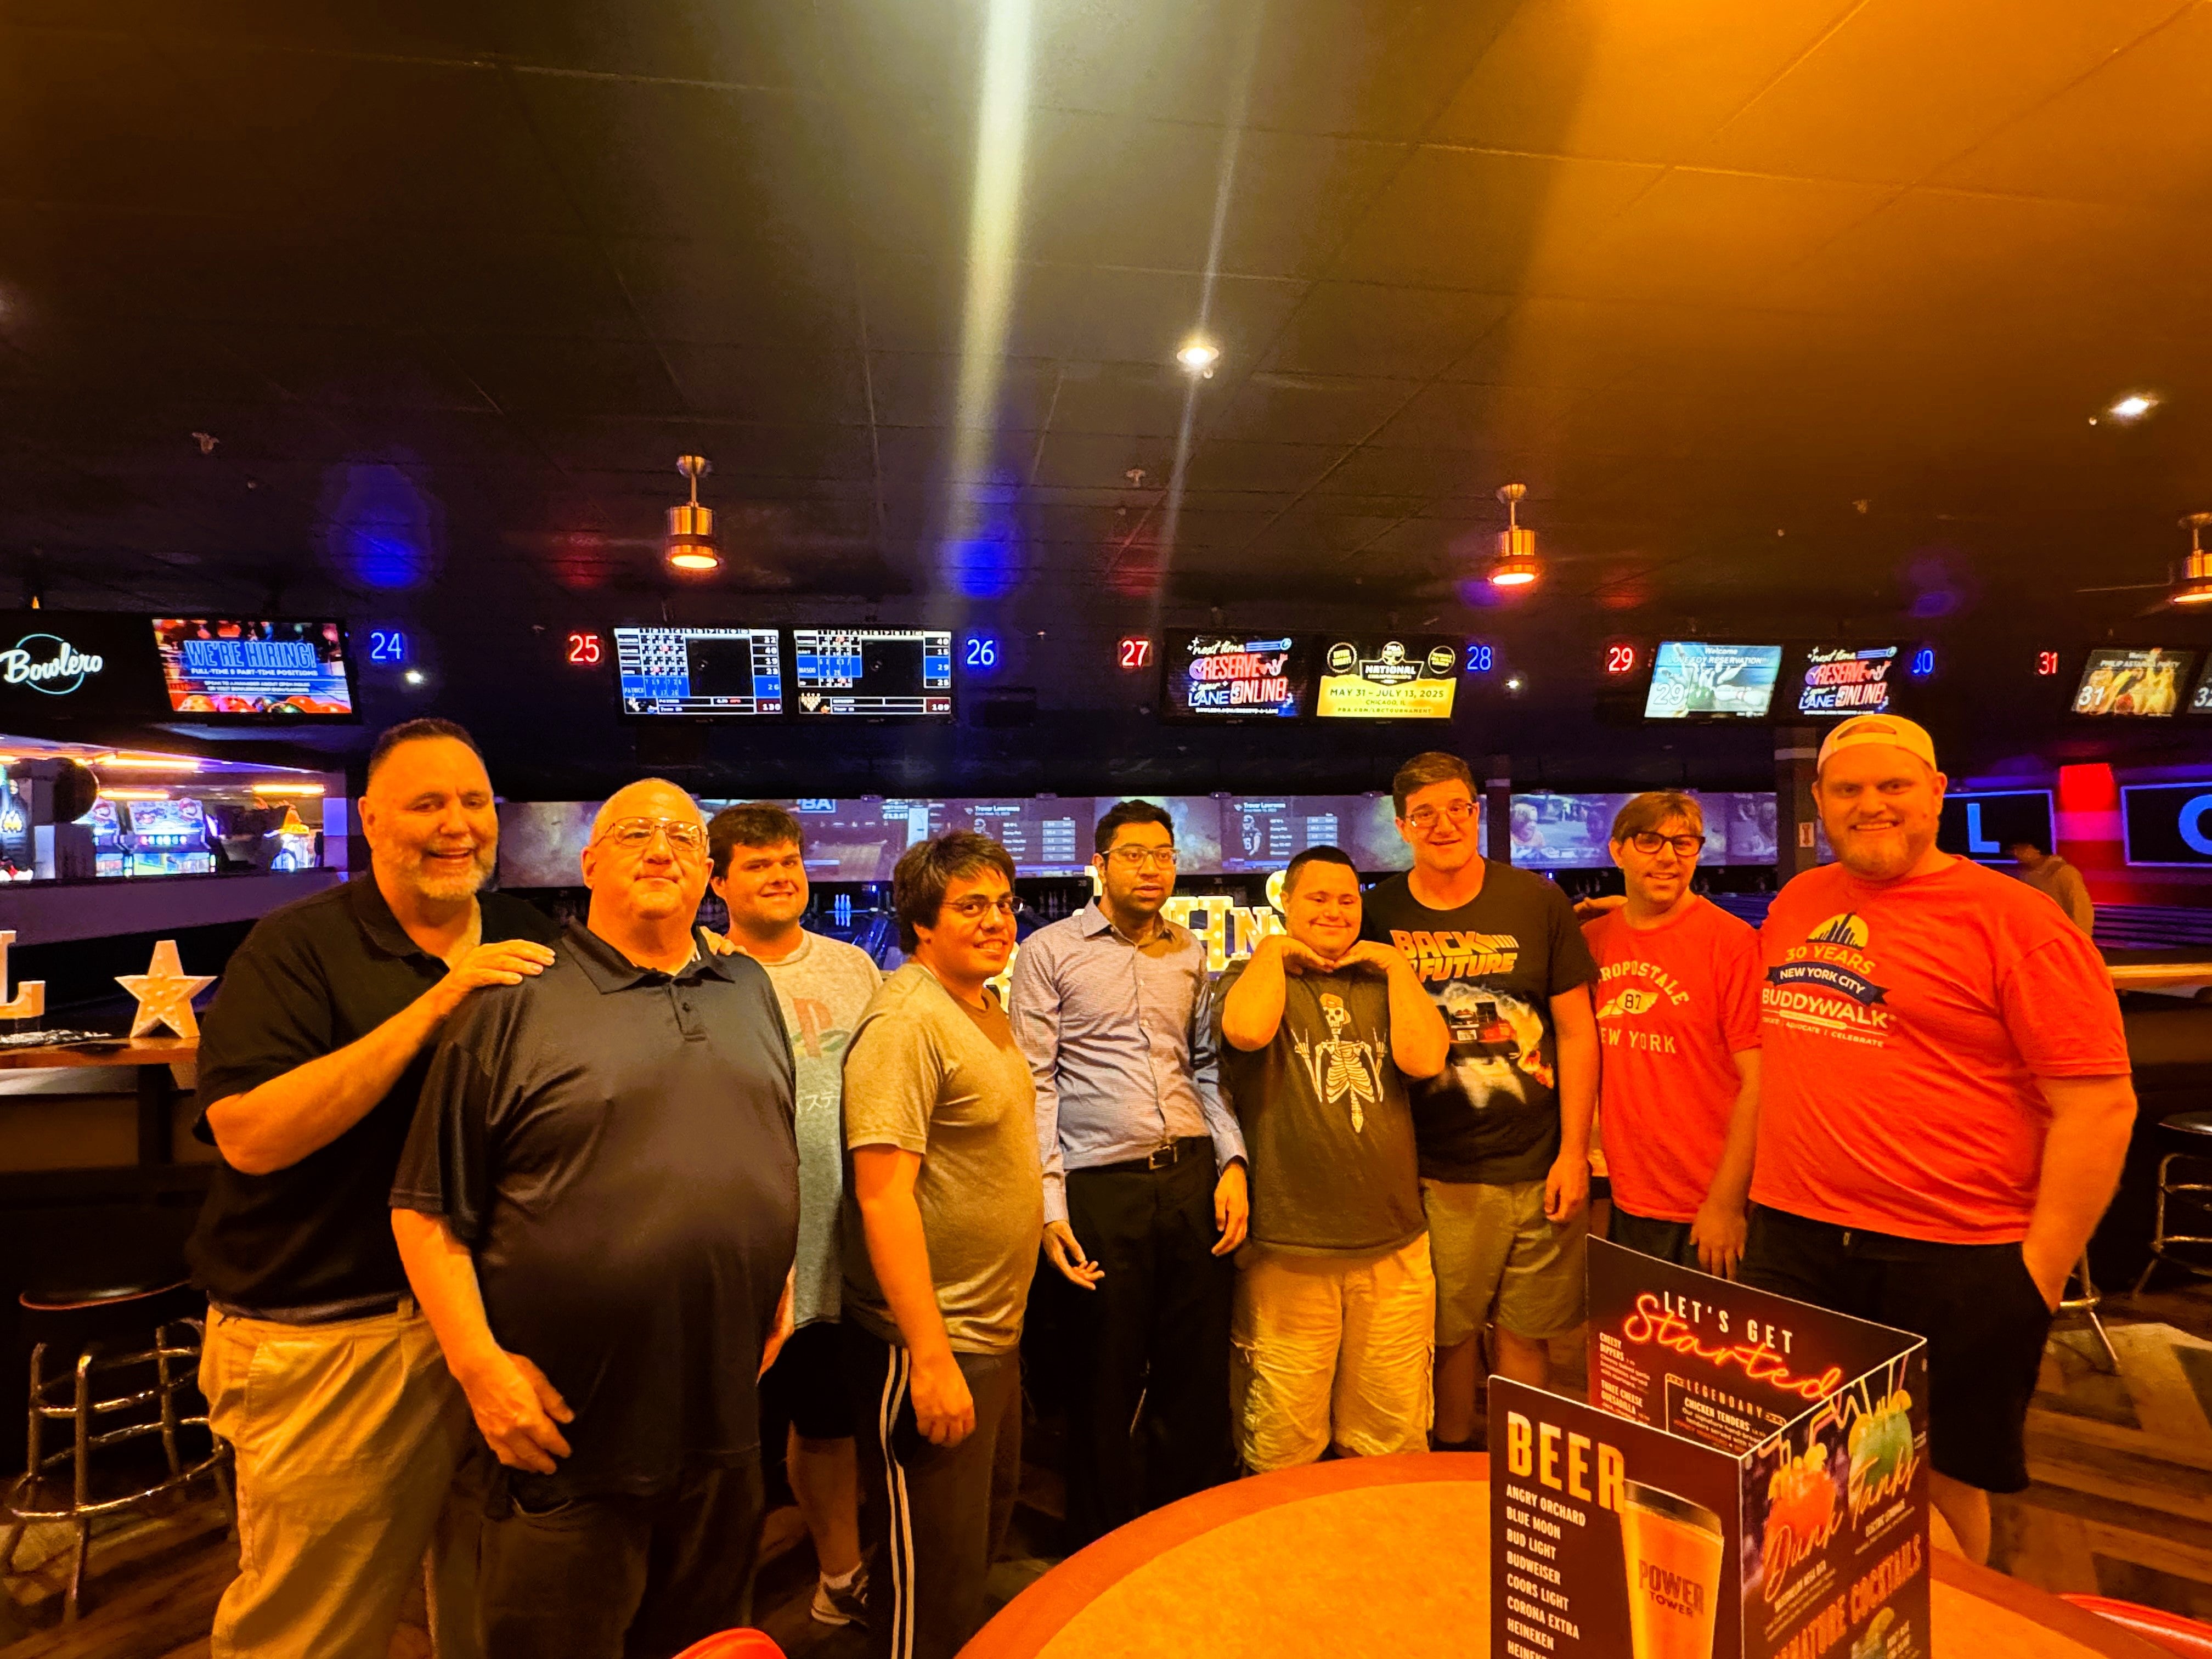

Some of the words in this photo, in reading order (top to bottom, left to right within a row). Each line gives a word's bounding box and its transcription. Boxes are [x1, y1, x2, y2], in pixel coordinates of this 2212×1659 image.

[184, 641, 244, 667] WE'RE
[245, 641, 317, 669] HIRING!
[371, 631, 403, 661] 24
[568, 635, 600, 662] 25
[966, 639, 995, 666] 26
[1120, 640, 1149, 667] 27
[1192, 641, 1221, 655] next
[1221, 640, 1245, 653] time
[1466, 646, 1492, 672] 28
[1608, 647, 1634, 672] 29
[1203, 653, 1262, 680] RESERVE
[1365, 664, 1416, 675] NATIONAL
[1816, 661, 1869, 685] RESERVE
[2038, 652, 2057, 675] 31
[1188, 690, 1230, 707] LANE
[1330, 689, 1353, 697] MAY
[1356, 689, 1365, 697] 31
[1376, 689, 1401, 697] JULY
[1405, 689, 1417, 699] 13,
[1420, 690, 1444, 698] 2025
[1653, 684, 1685, 705] 29
[1798, 694, 1836, 710] LANE
[2078, 685, 2106, 706] 31
[1967, 803, 2000, 853] L
[1390, 930, 1502, 958] BACK
[1418, 953, 1518, 983] FUTURE
[1785, 946, 1808, 962] 30
[1814, 945, 1876, 975] YEARS
[1599, 960, 1690, 1006] ROPOSTALE
[1780, 967, 1806, 980] NEW
[1807, 967, 1840, 982] YORK
[1838, 975, 1866, 994] CITY
[1625, 994, 1642, 1010] 87
[1762, 988, 1888, 1029] BUDDYWALK
[1600, 1027, 1621, 1046] EW
[1628, 1030, 1676, 1054] YORK
[1786, 1021, 1820, 1034] ADVOCATE
[1831, 1030, 1884, 1048] CELEBRATE
[1664, 1291, 1729, 1333] LET'S
[1747, 1318, 1793, 1354] GET
[1624, 1294, 1842, 1399] Started
[1601, 1379, 1619, 1396] THREE
[1620, 1389, 1643, 1408] CHEESE
[1686, 1379, 1763, 1418] LEGENDARY
[1684, 1397, 1715, 1418] CHICKEN
[1717, 1409, 1751, 1432] TENDERS
[1508, 1410, 1625, 1514] BEER
[1506, 1483, 1538, 1508] ANGRY
[1540, 1497, 1587, 1527] ORCHARD
[1506, 1506, 1531, 1527] BLUE
[1533, 1516, 1561, 1540] MOON
[1506, 1528, 1526, 1548] BUD
[1528, 1537, 1556, 1560] LIGHT
[1506, 1550, 1561, 1585] BUDWEISER
[1850, 1534, 1922, 1624] COCKTAILS
[1507, 1573, 1538, 1599] COORS
[1541, 1587, 1570, 1612] LIGHT
[1638, 1559, 1705, 1616] POWER
[1507, 1595, 1546, 1625] CORONA
[1548, 1613, 1580, 1640] EXTRA
[1649, 1590, 1694, 1618] TOWER
[1507, 1617, 1554, 1651] HEINEKEN
[1508, 1639, 1550, 1659] HEINE
